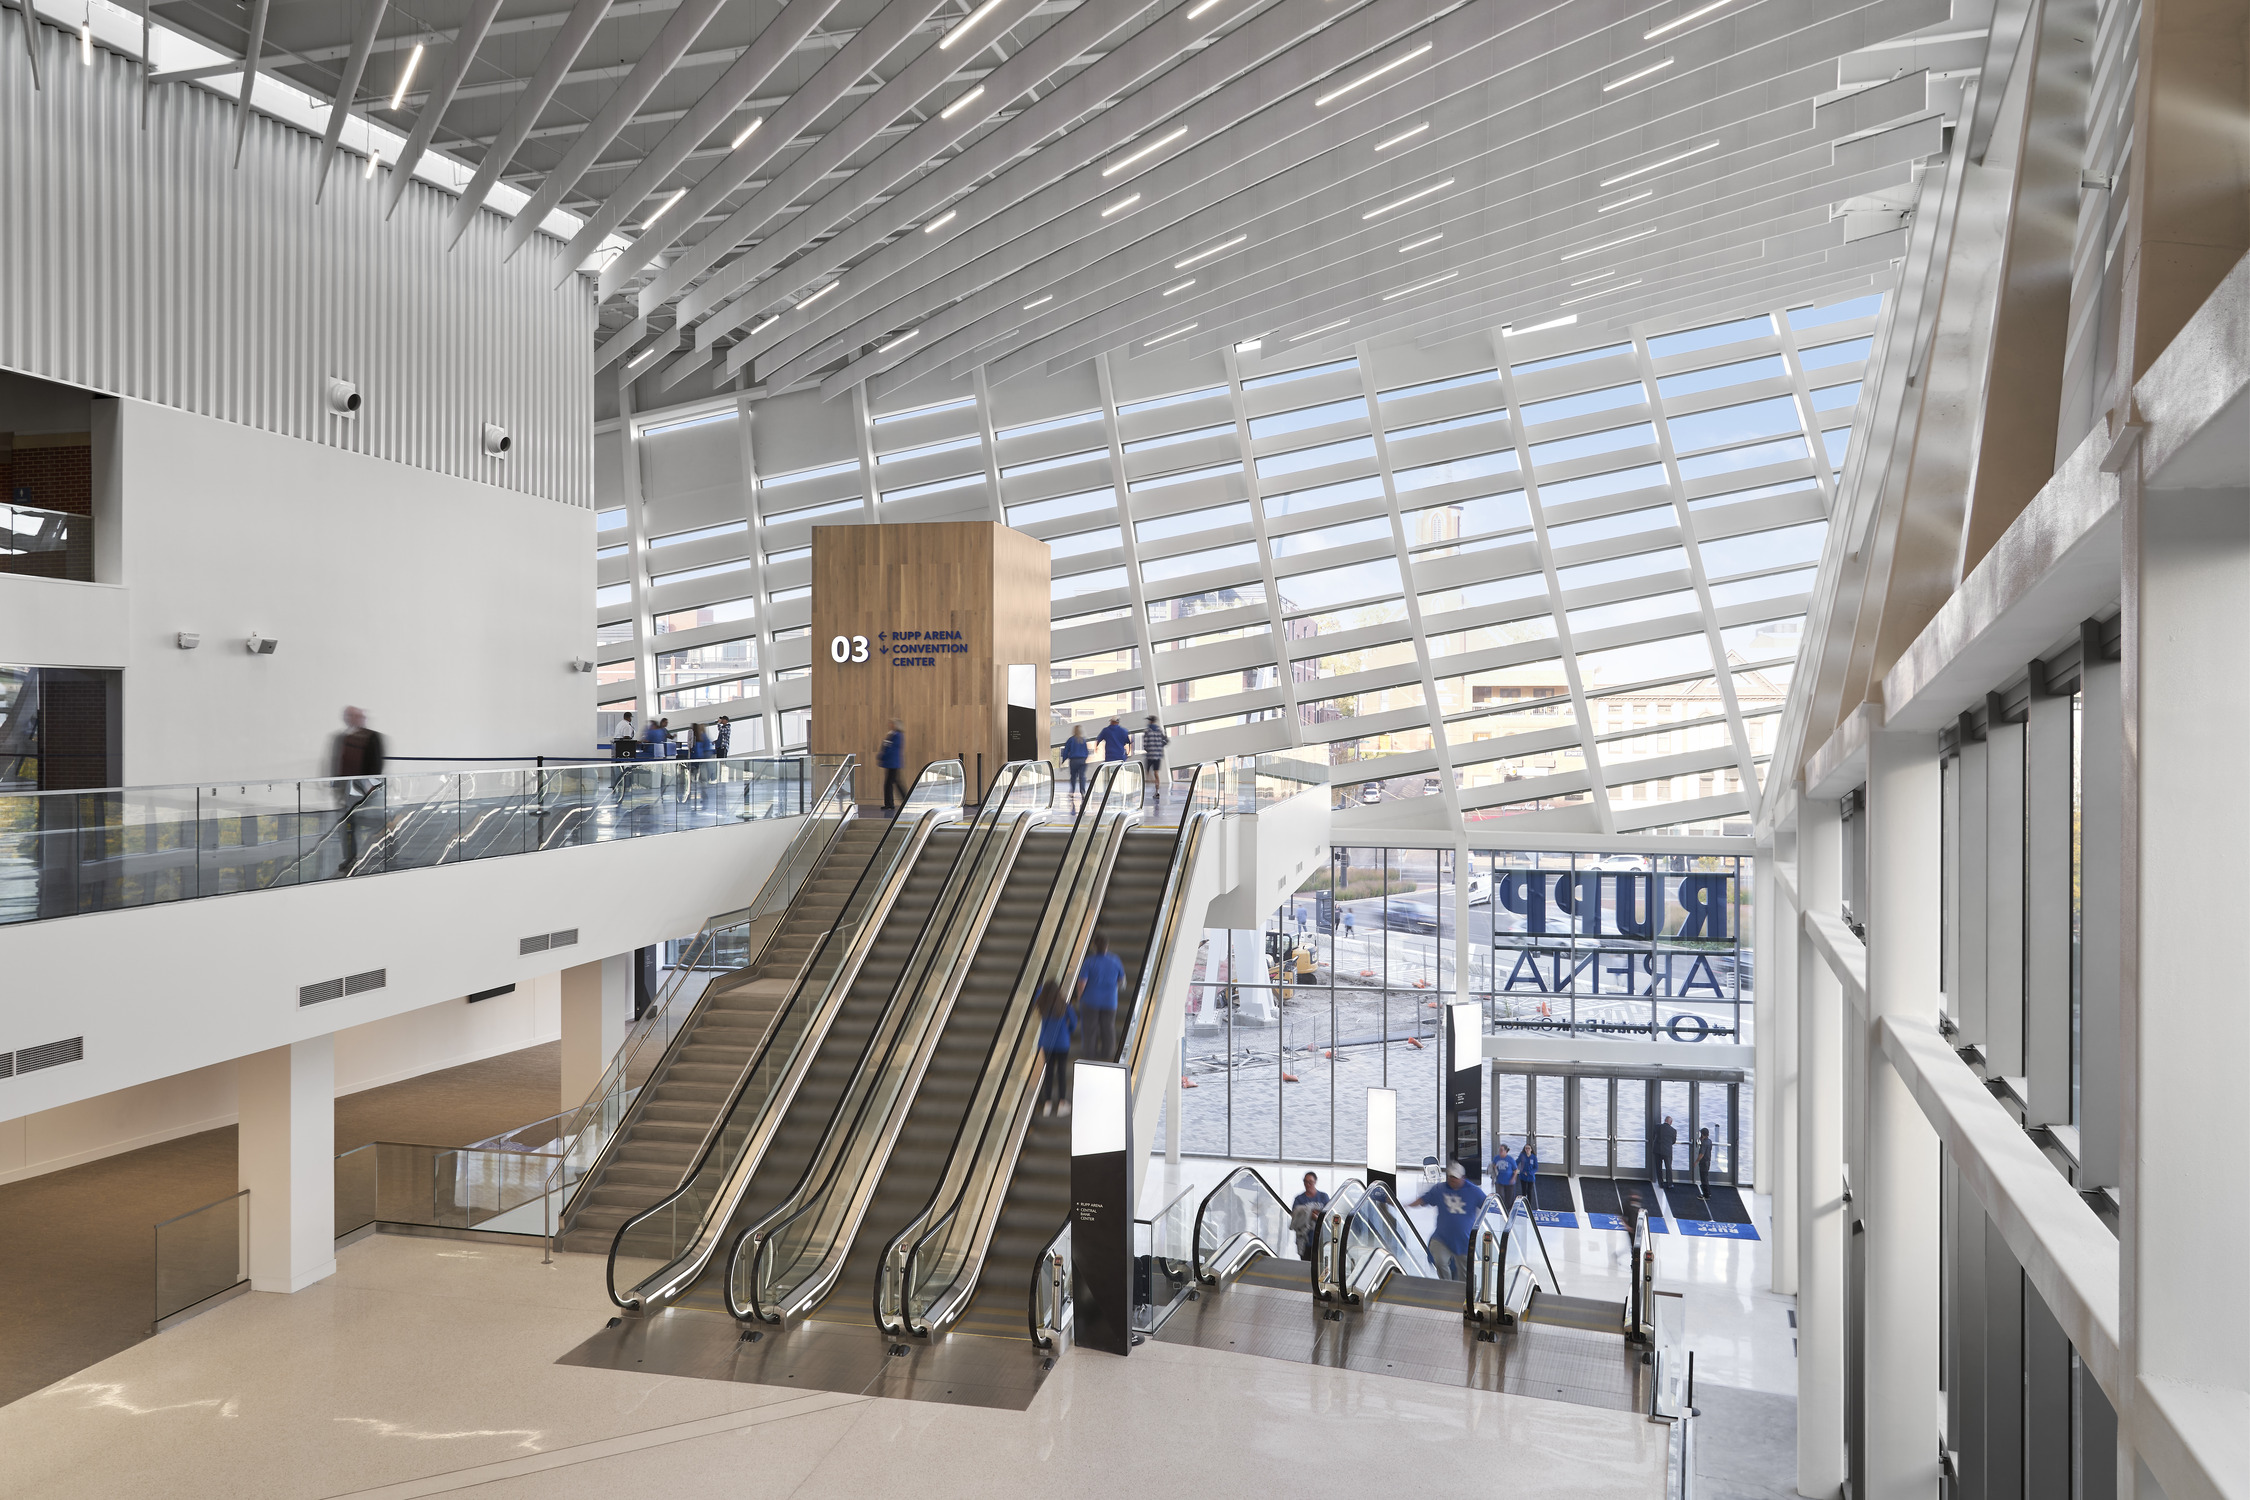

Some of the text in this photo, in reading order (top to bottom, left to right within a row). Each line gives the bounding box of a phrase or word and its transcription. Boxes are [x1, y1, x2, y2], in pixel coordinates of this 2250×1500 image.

[892, 630, 963, 640] RUPP ARENA
[830, 635, 870, 663] 03
[892, 643, 968, 654] CONVENTION
[892, 657, 936, 667] CENTER
[1697, 1226, 1740, 1235] RUPP
